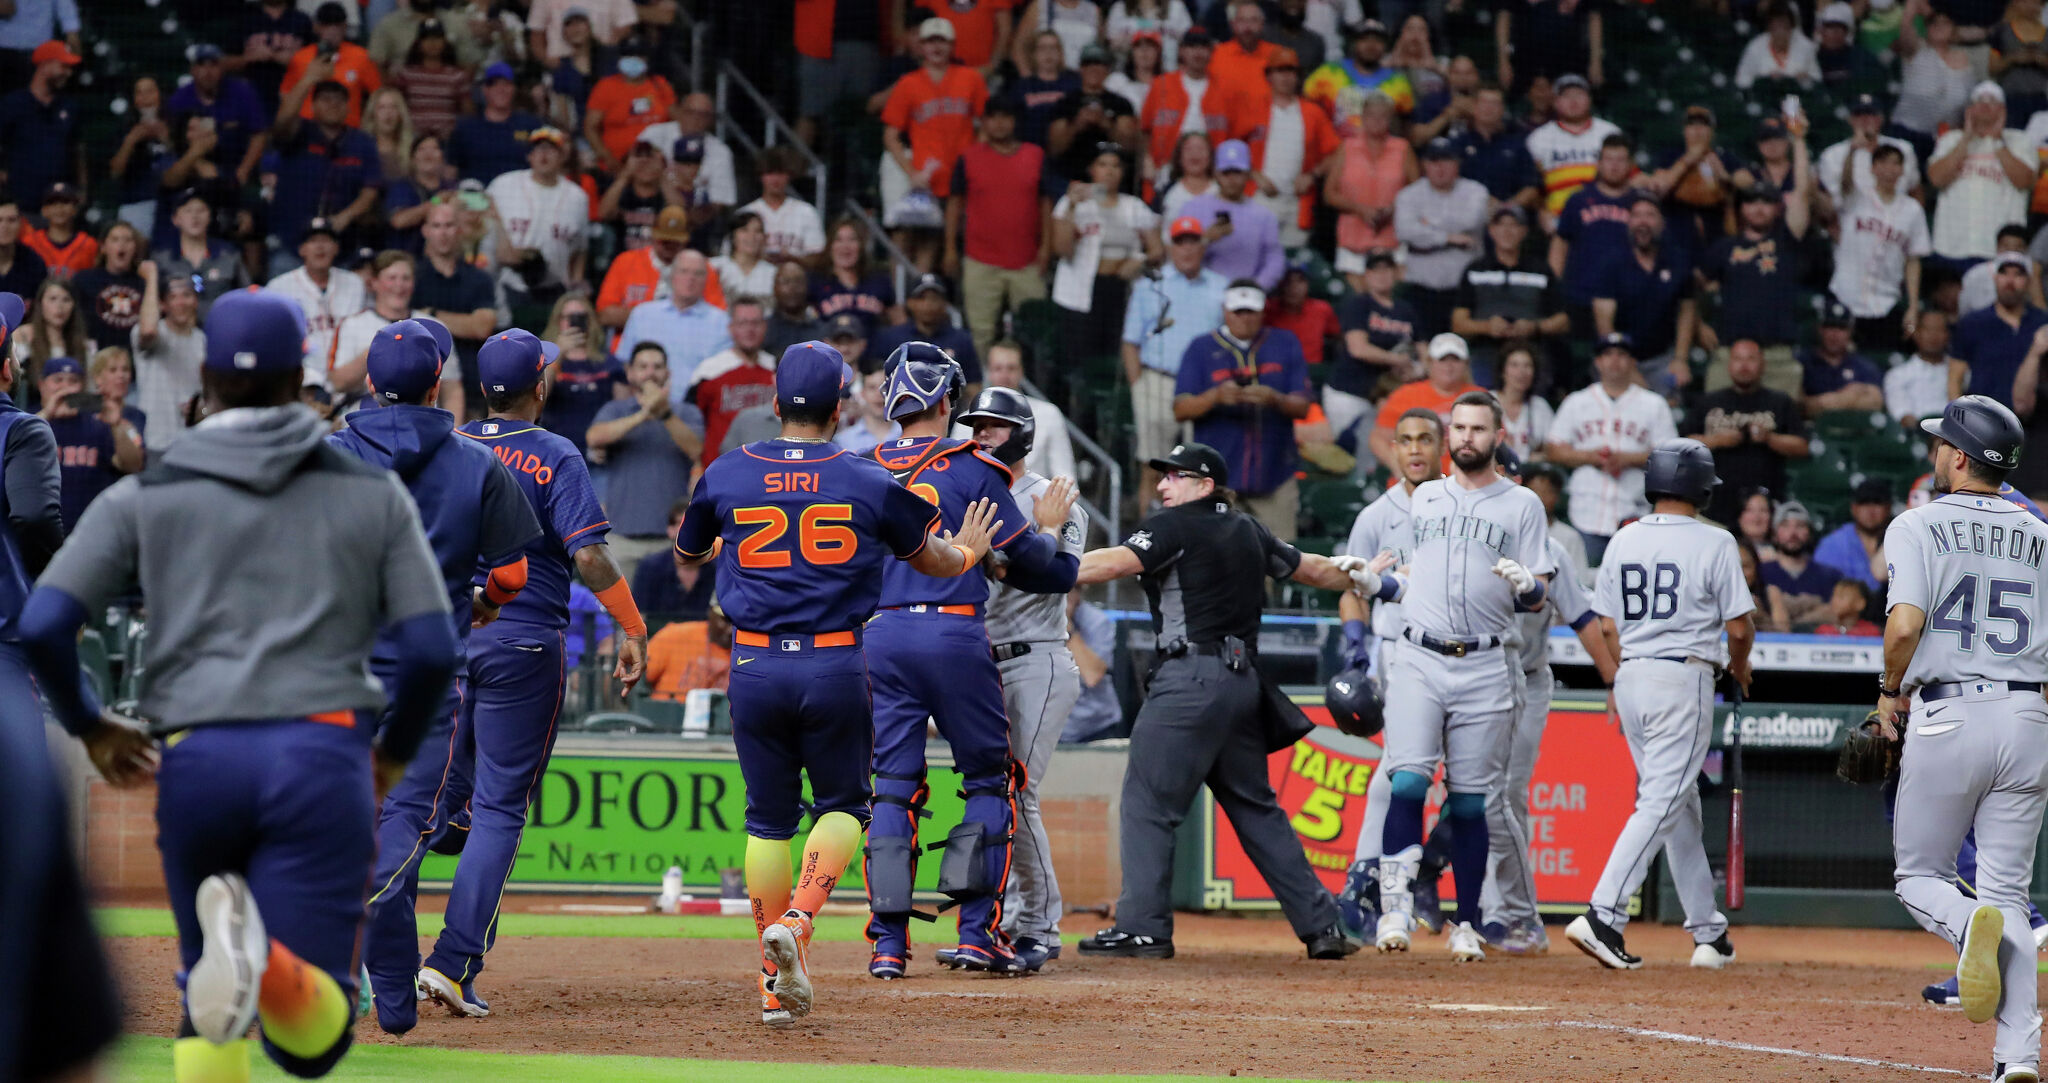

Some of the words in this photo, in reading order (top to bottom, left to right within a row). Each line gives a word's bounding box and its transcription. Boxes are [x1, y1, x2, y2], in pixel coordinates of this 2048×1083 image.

[763, 471, 820, 493] SIRI
[732, 503, 859, 568] 26
[1927, 518, 2046, 571] NEGRÓN
[1618, 559, 1686, 622] BB
[1930, 571, 2035, 657] 45
[1722, 711, 1844, 744] Academy
[1290, 739, 1372, 796] TAKE
[1290, 786, 1345, 842] 5
[1532, 781, 1587, 811] CAR
